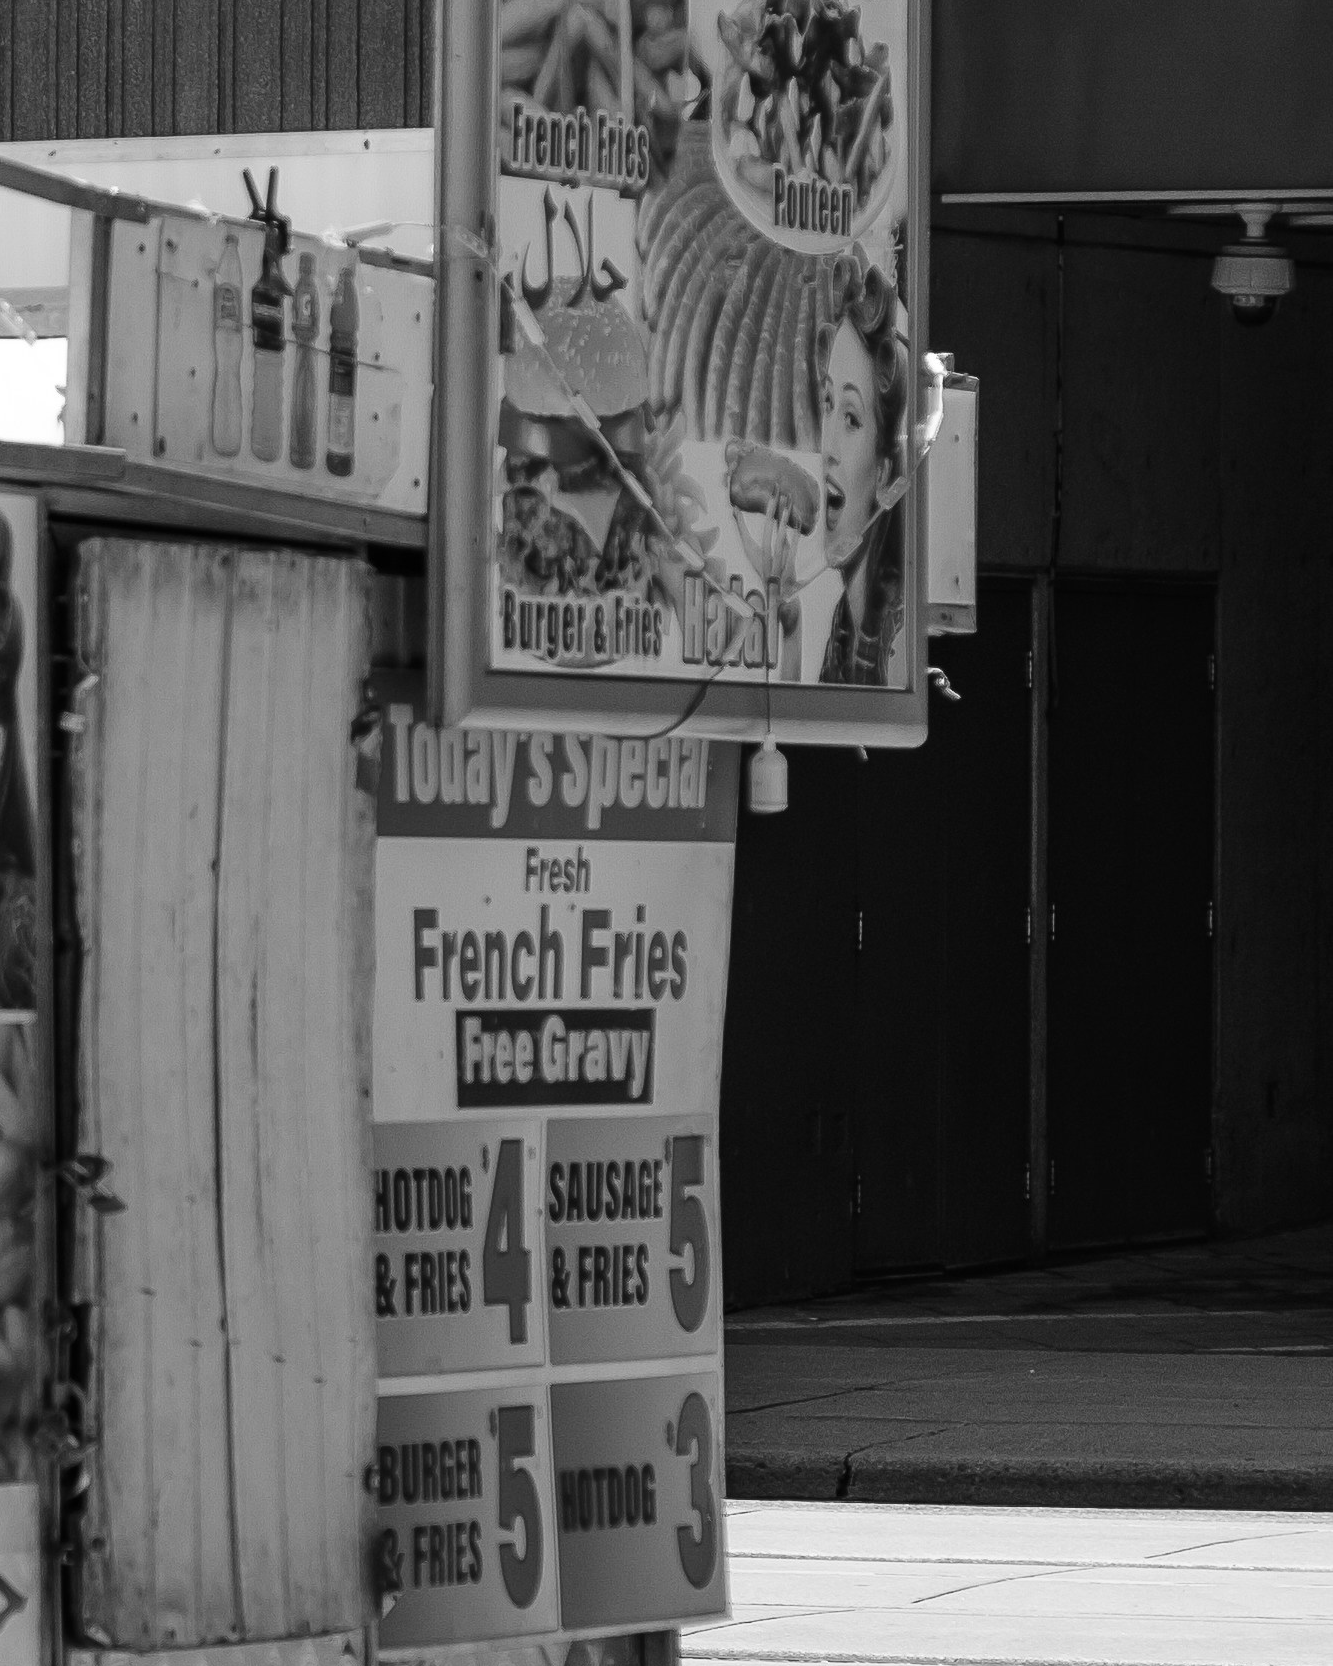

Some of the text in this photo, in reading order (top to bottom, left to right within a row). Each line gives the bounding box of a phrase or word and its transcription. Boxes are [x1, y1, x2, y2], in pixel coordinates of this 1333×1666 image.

[511, 101, 650, 187] French Fries
[772, 163, 856, 238] Pouteen
[521, 184, 630, 310] حلال
[503, 571, 781, 669] Burger & Fries Halal
[388, 702, 710, 831] Today's Special
[524, 844, 592, 896] Fresh
[412, 903, 689, 1004] French Fries
[461, 1016, 652, 1098] Free Gravy
[374, 1165, 474, 1231] HOTDOG
[548, 1158, 664, 1223] SAUSAGE
[375, 1251, 398, 1318] &
[404, 1248, 472, 1316] FRIES
[551, 1244, 573, 1309] &
[577, 1241, 650, 1308] FRIES
[379, 1438, 483, 1506] BURGER
[559, 1462, 658, 1533] HOTDOG
[413, 1519, 483, 1589] FRIES
